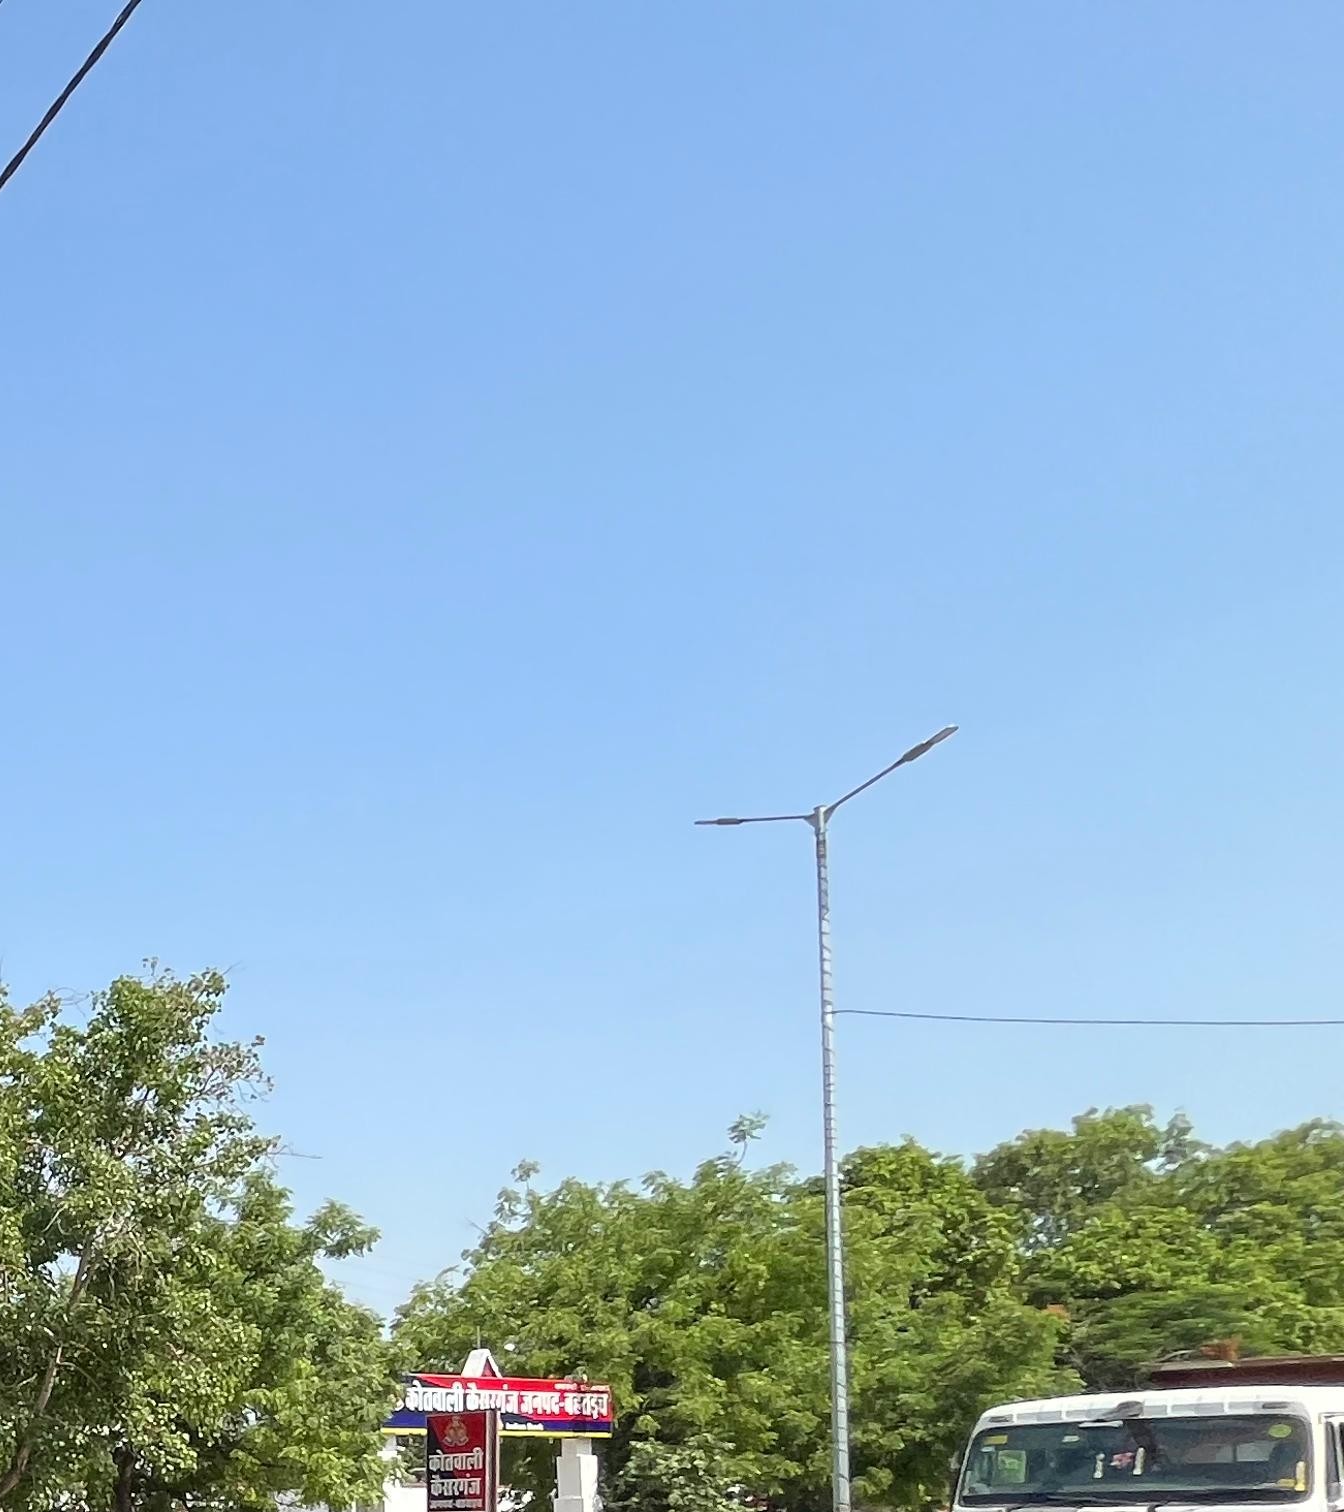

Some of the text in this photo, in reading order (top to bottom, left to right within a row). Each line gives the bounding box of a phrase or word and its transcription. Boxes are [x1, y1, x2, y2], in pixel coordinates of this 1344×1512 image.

[405, 1380, 464, 1412] कोतवाली
[466, 1382, 518, 1414] कैसरगंज
[428, 1447, 483, 1471] कोतवाली
[430, 1473, 482, 1496] कैसरगंज
